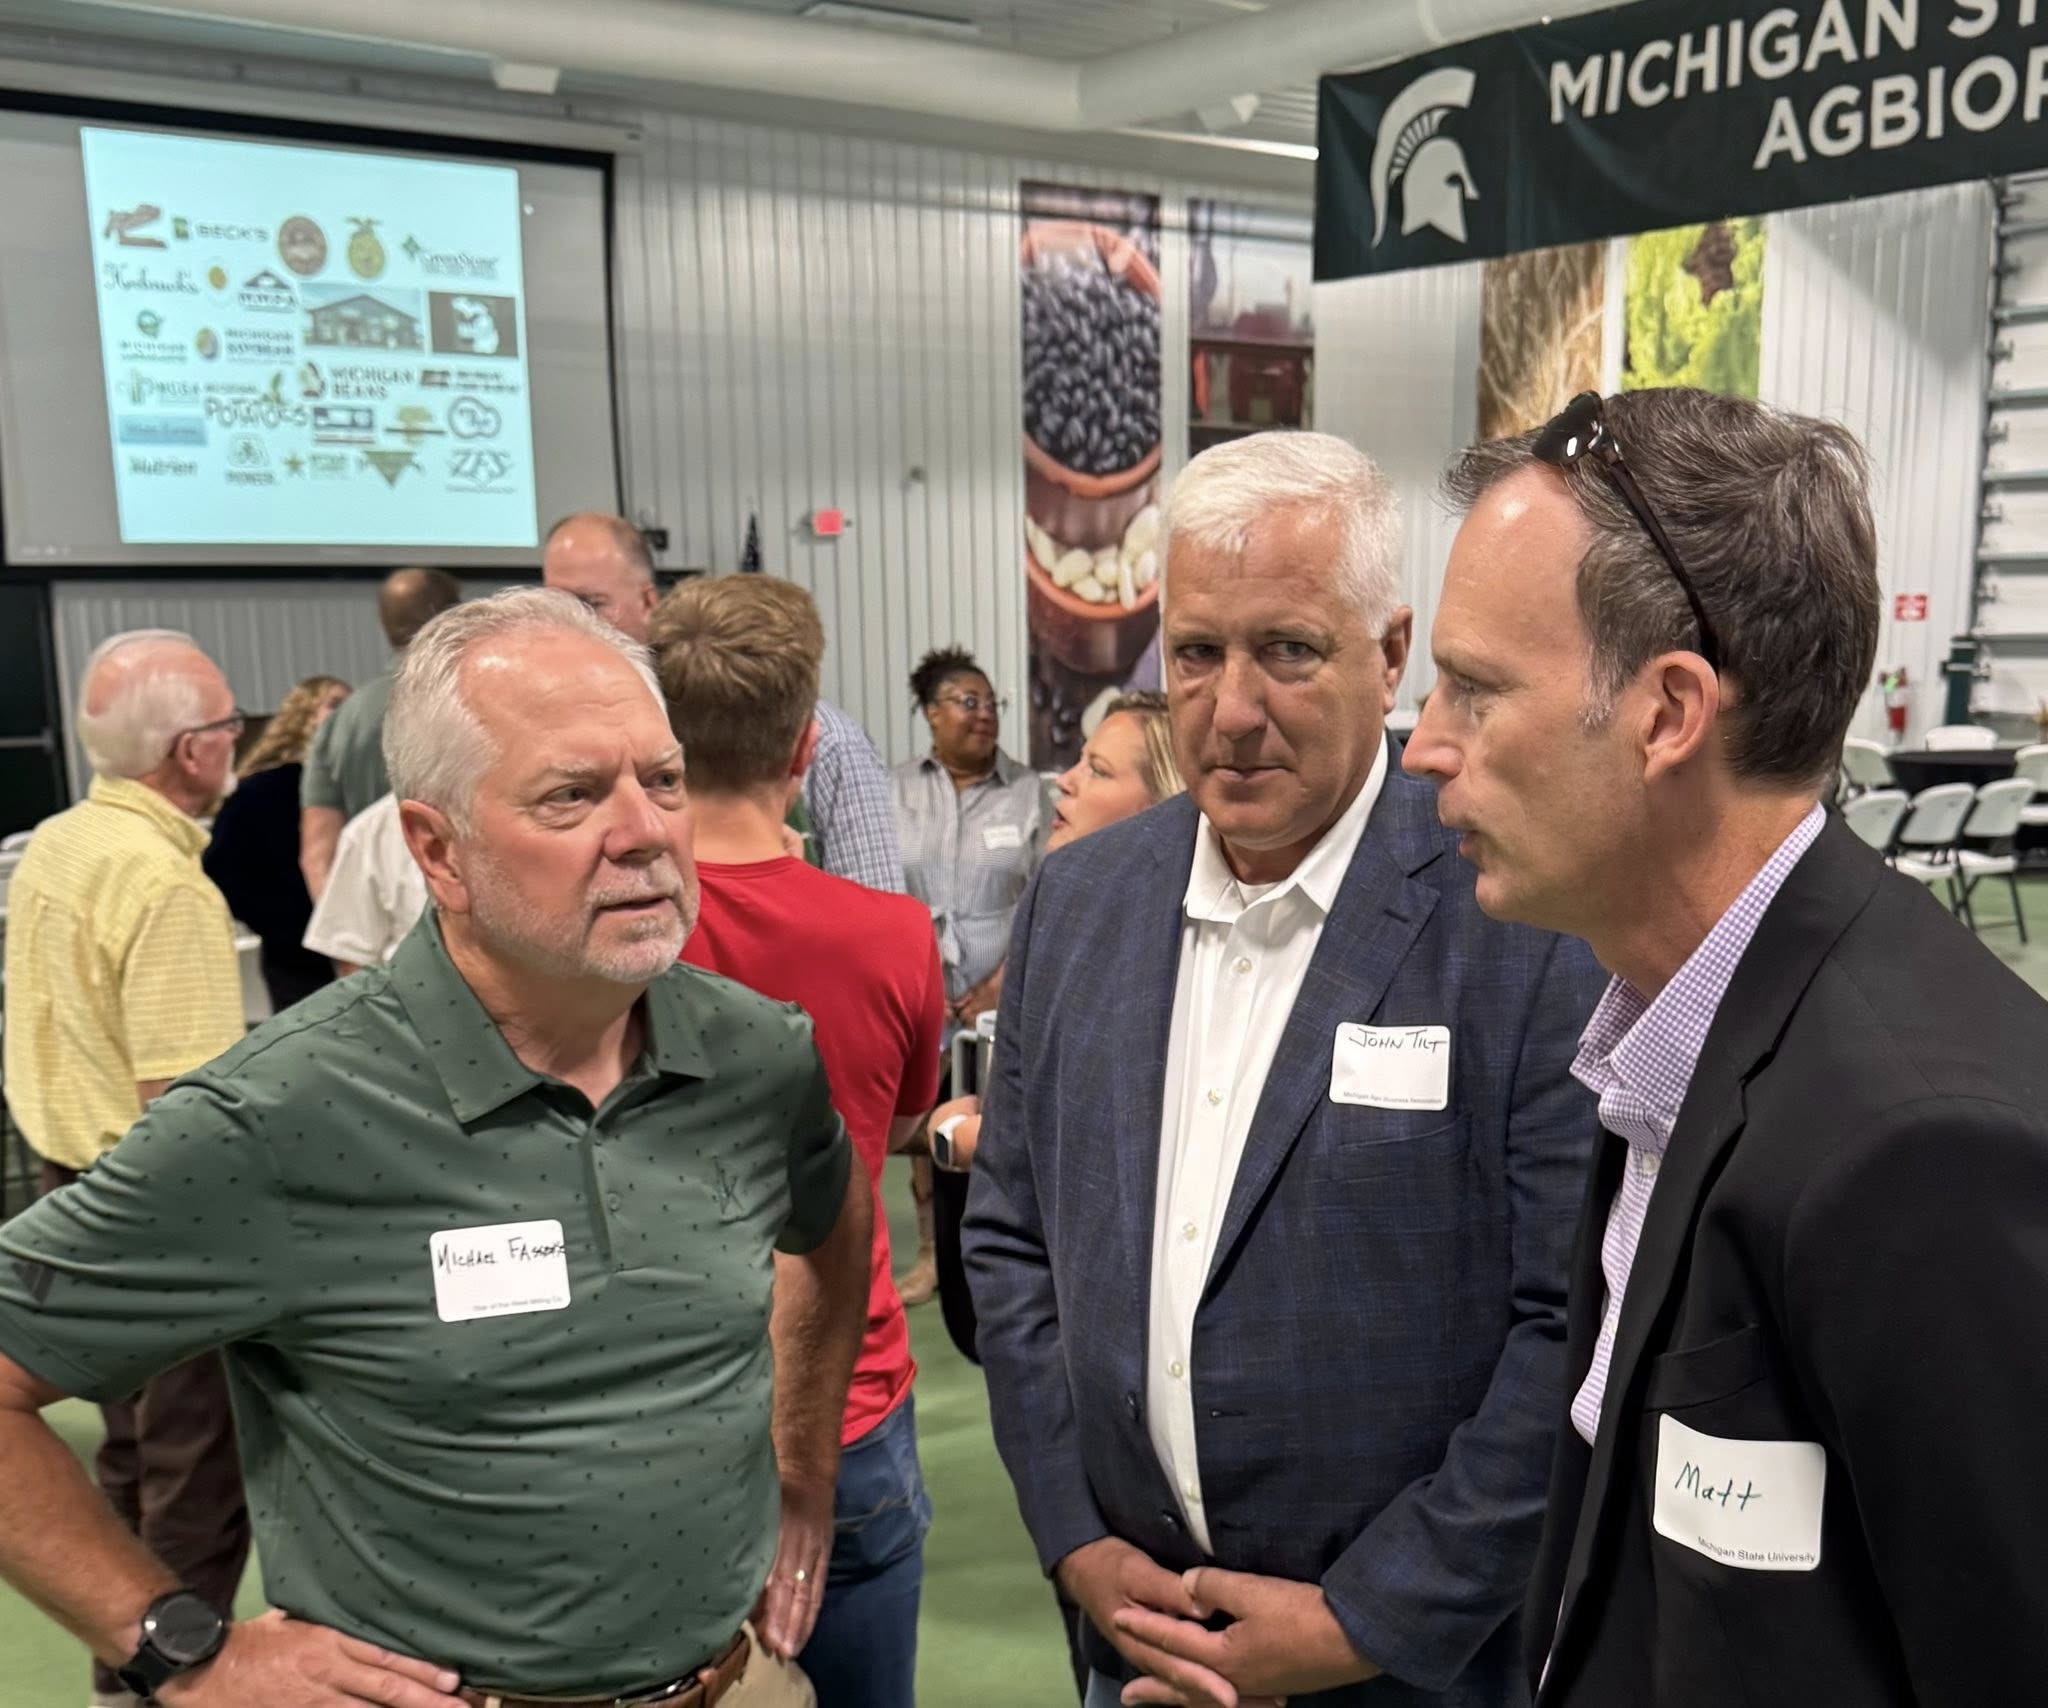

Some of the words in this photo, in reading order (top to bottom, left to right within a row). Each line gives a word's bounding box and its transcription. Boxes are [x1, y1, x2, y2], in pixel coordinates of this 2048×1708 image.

[1550, 0, 1917, 123] MICHIGAN
[330, 367, 415, 384] MICHIGAN
[333, 384, 388, 399] BEANS
[1349, 1027, 1404, 1048] JOHN
[1405, 1028, 1447, 1053] TILT
[1674, 1461, 1763, 1512] Matt
[1698, 1536, 1735, 1557] Michigan
[1737, 1549, 1765, 1562] State
[1768, 1552, 1815, 1564] University
